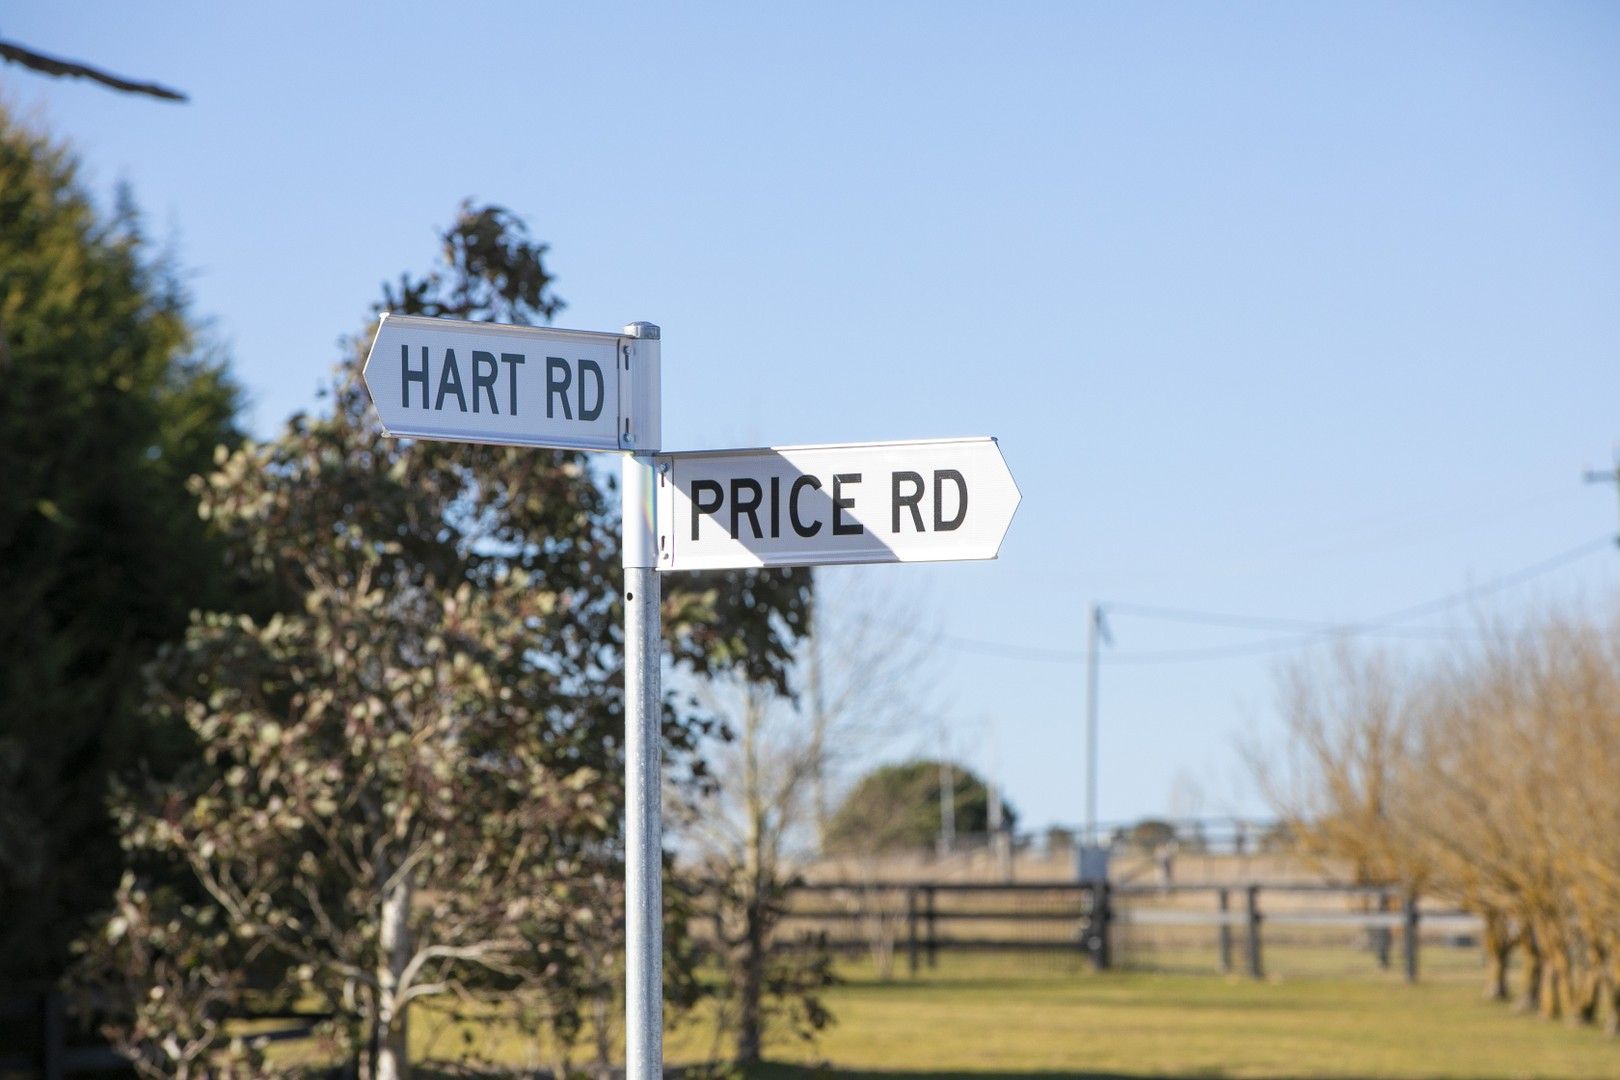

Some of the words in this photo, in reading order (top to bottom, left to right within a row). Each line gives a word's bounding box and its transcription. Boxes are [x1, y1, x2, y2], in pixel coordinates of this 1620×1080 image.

[401, 344, 526, 416] HART
[545, 356, 605, 422] RD
[690, 473, 864, 541] PRICE
[892, 469, 968, 533] RD
